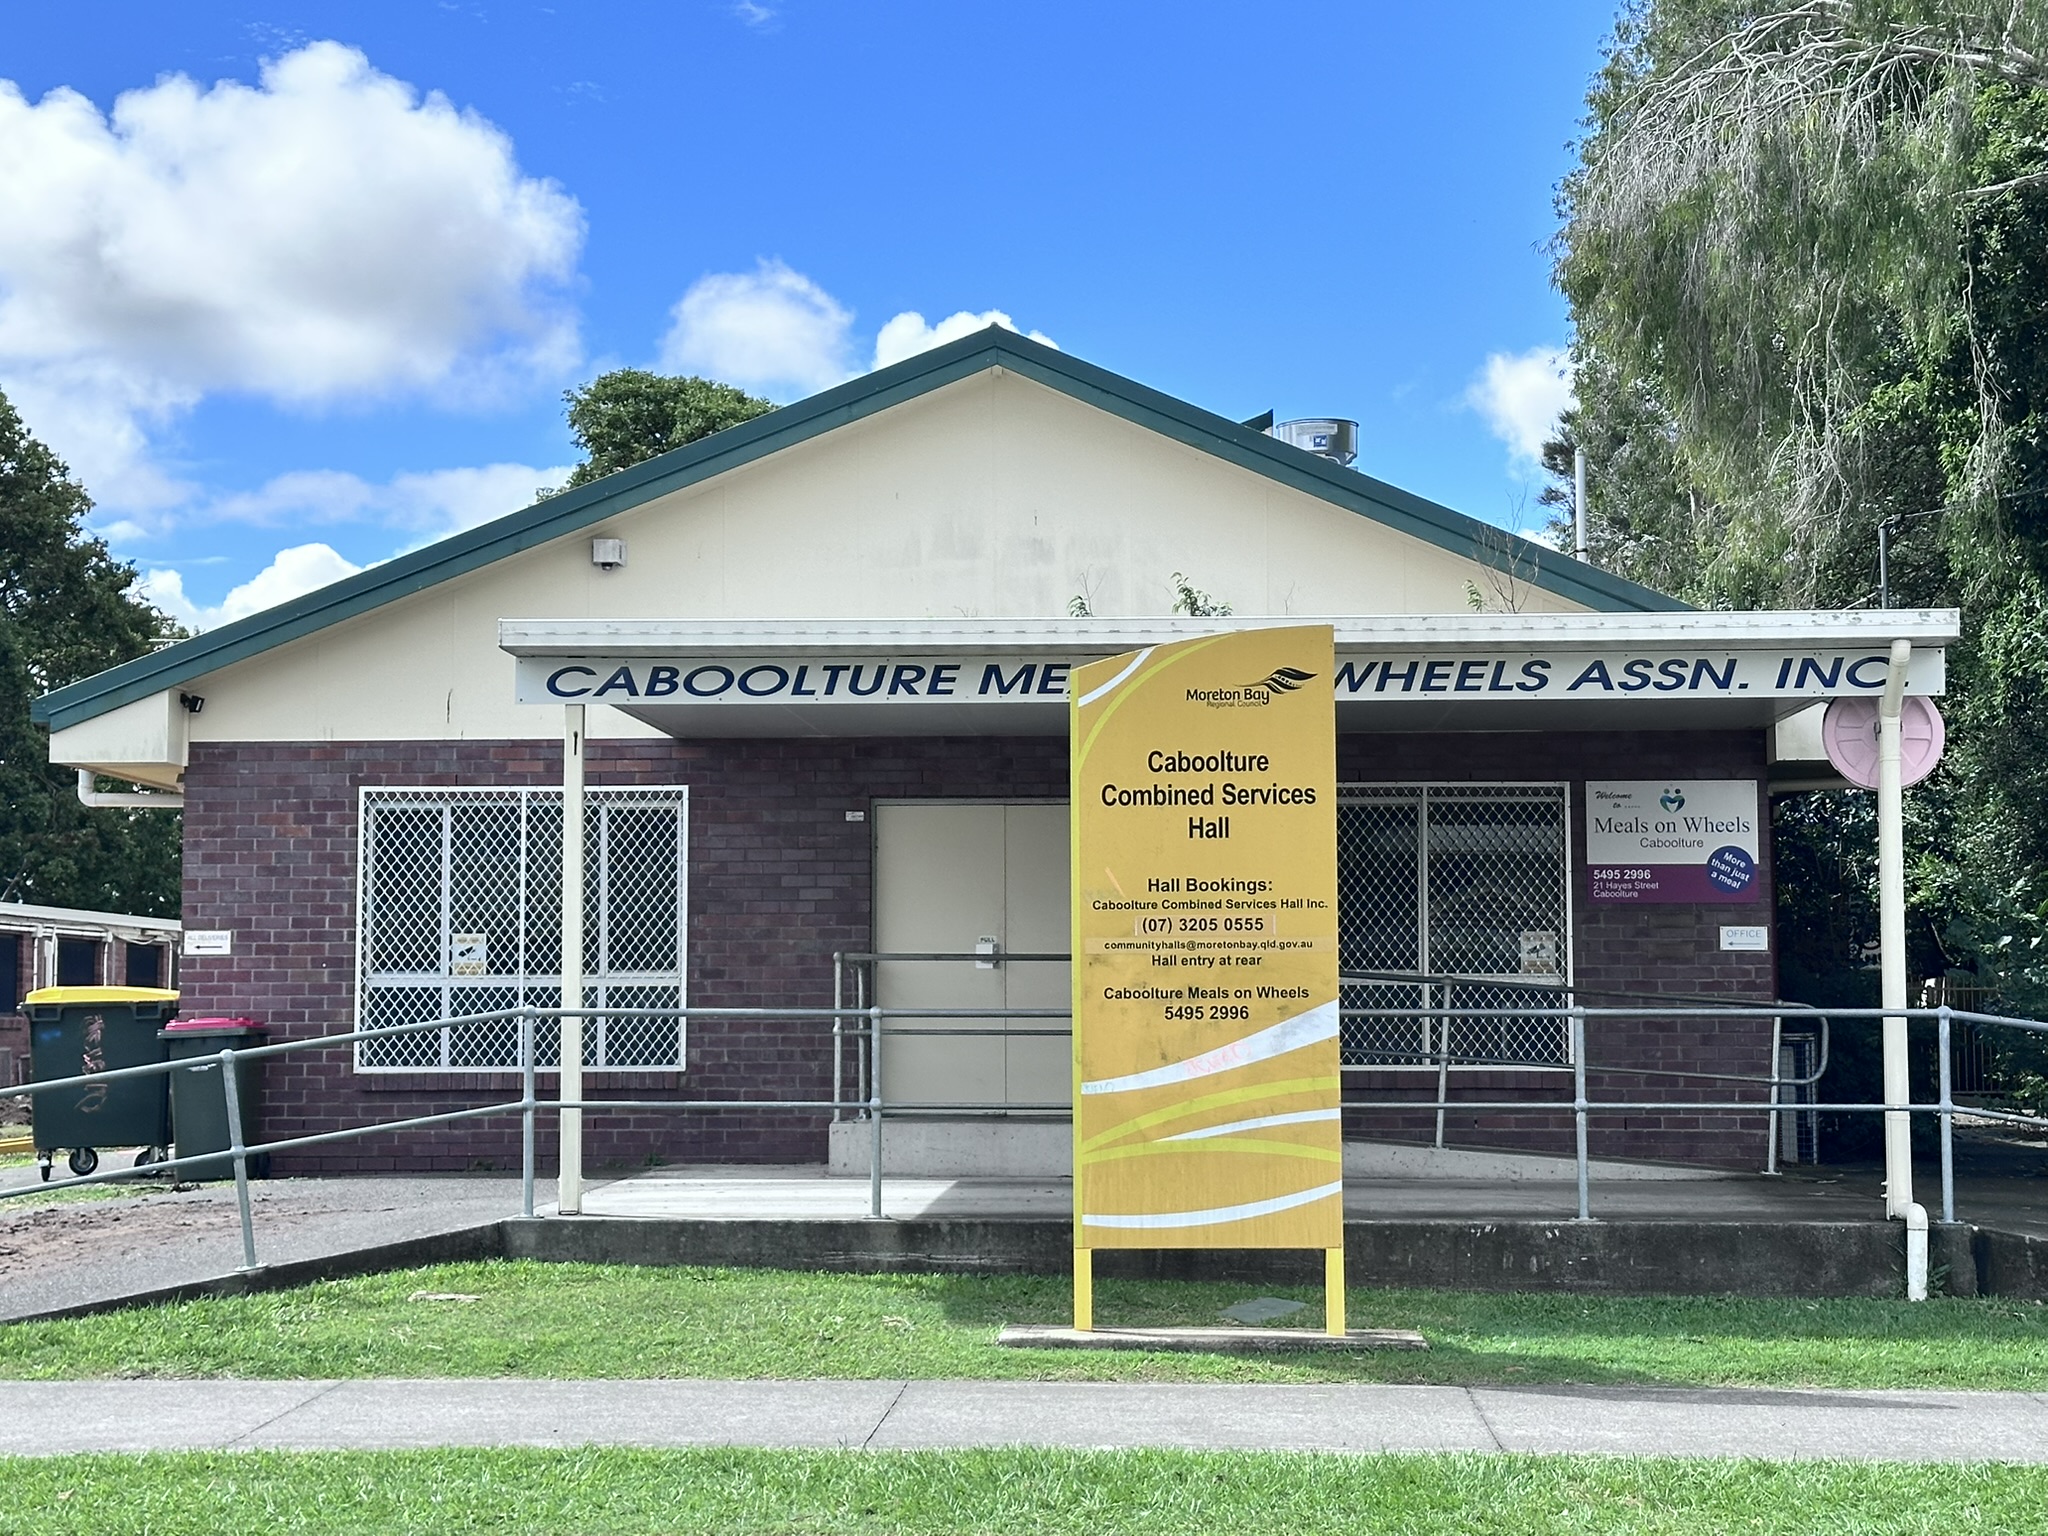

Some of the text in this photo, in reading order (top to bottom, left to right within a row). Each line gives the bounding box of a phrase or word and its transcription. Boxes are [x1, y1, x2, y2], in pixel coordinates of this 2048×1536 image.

[546, 664, 961, 697] CABOOLTURE
[978, 663, 1071, 694] ME
[1566, 658, 1750, 691] ASSN.
[1186, 688, 1270, 705] Moreton Bay
[1207, 701, 1235, 709] Regional
[1147, 750, 1269, 773] Caboolture
[1101, 782, 1316, 806] Combined Services
[1595, 791, 1632, 799] Welcome
[1188, 817, 1229, 839] Hall
[1594, 816, 1750, 833] Meals on Wheels
[1640, 837, 1704, 848] Caboolture
[1723, 852, 1746, 868] More
[1593, 869, 1651, 879] 5495 2996
[1711, 858, 1750, 882] than just
[1148, 877, 1273, 895] Hall Bookings:
[1593, 881, 1659, 891] 21 Hayes Street
[1718, 874, 1741, 889] meal
[1593, 890, 1639, 898] Caboolture
[1092, 898, 1328, 910] Caboolture Combined Services Hall Inc.
[1142, 917, 1264, 934] (07) 3205 0555
[1726, 929, 1762, 938] OFFICE
[1104, 940, 1313, 951] communityhalls@moretonbay.qld.gov.au
[1152, 955, 1262, 968] Hall entry at rear
[1104, 986, 1309, 1000] Caboolture Meals on Wheels
[1164, 1005, 1249, 1020] 5495 2996
